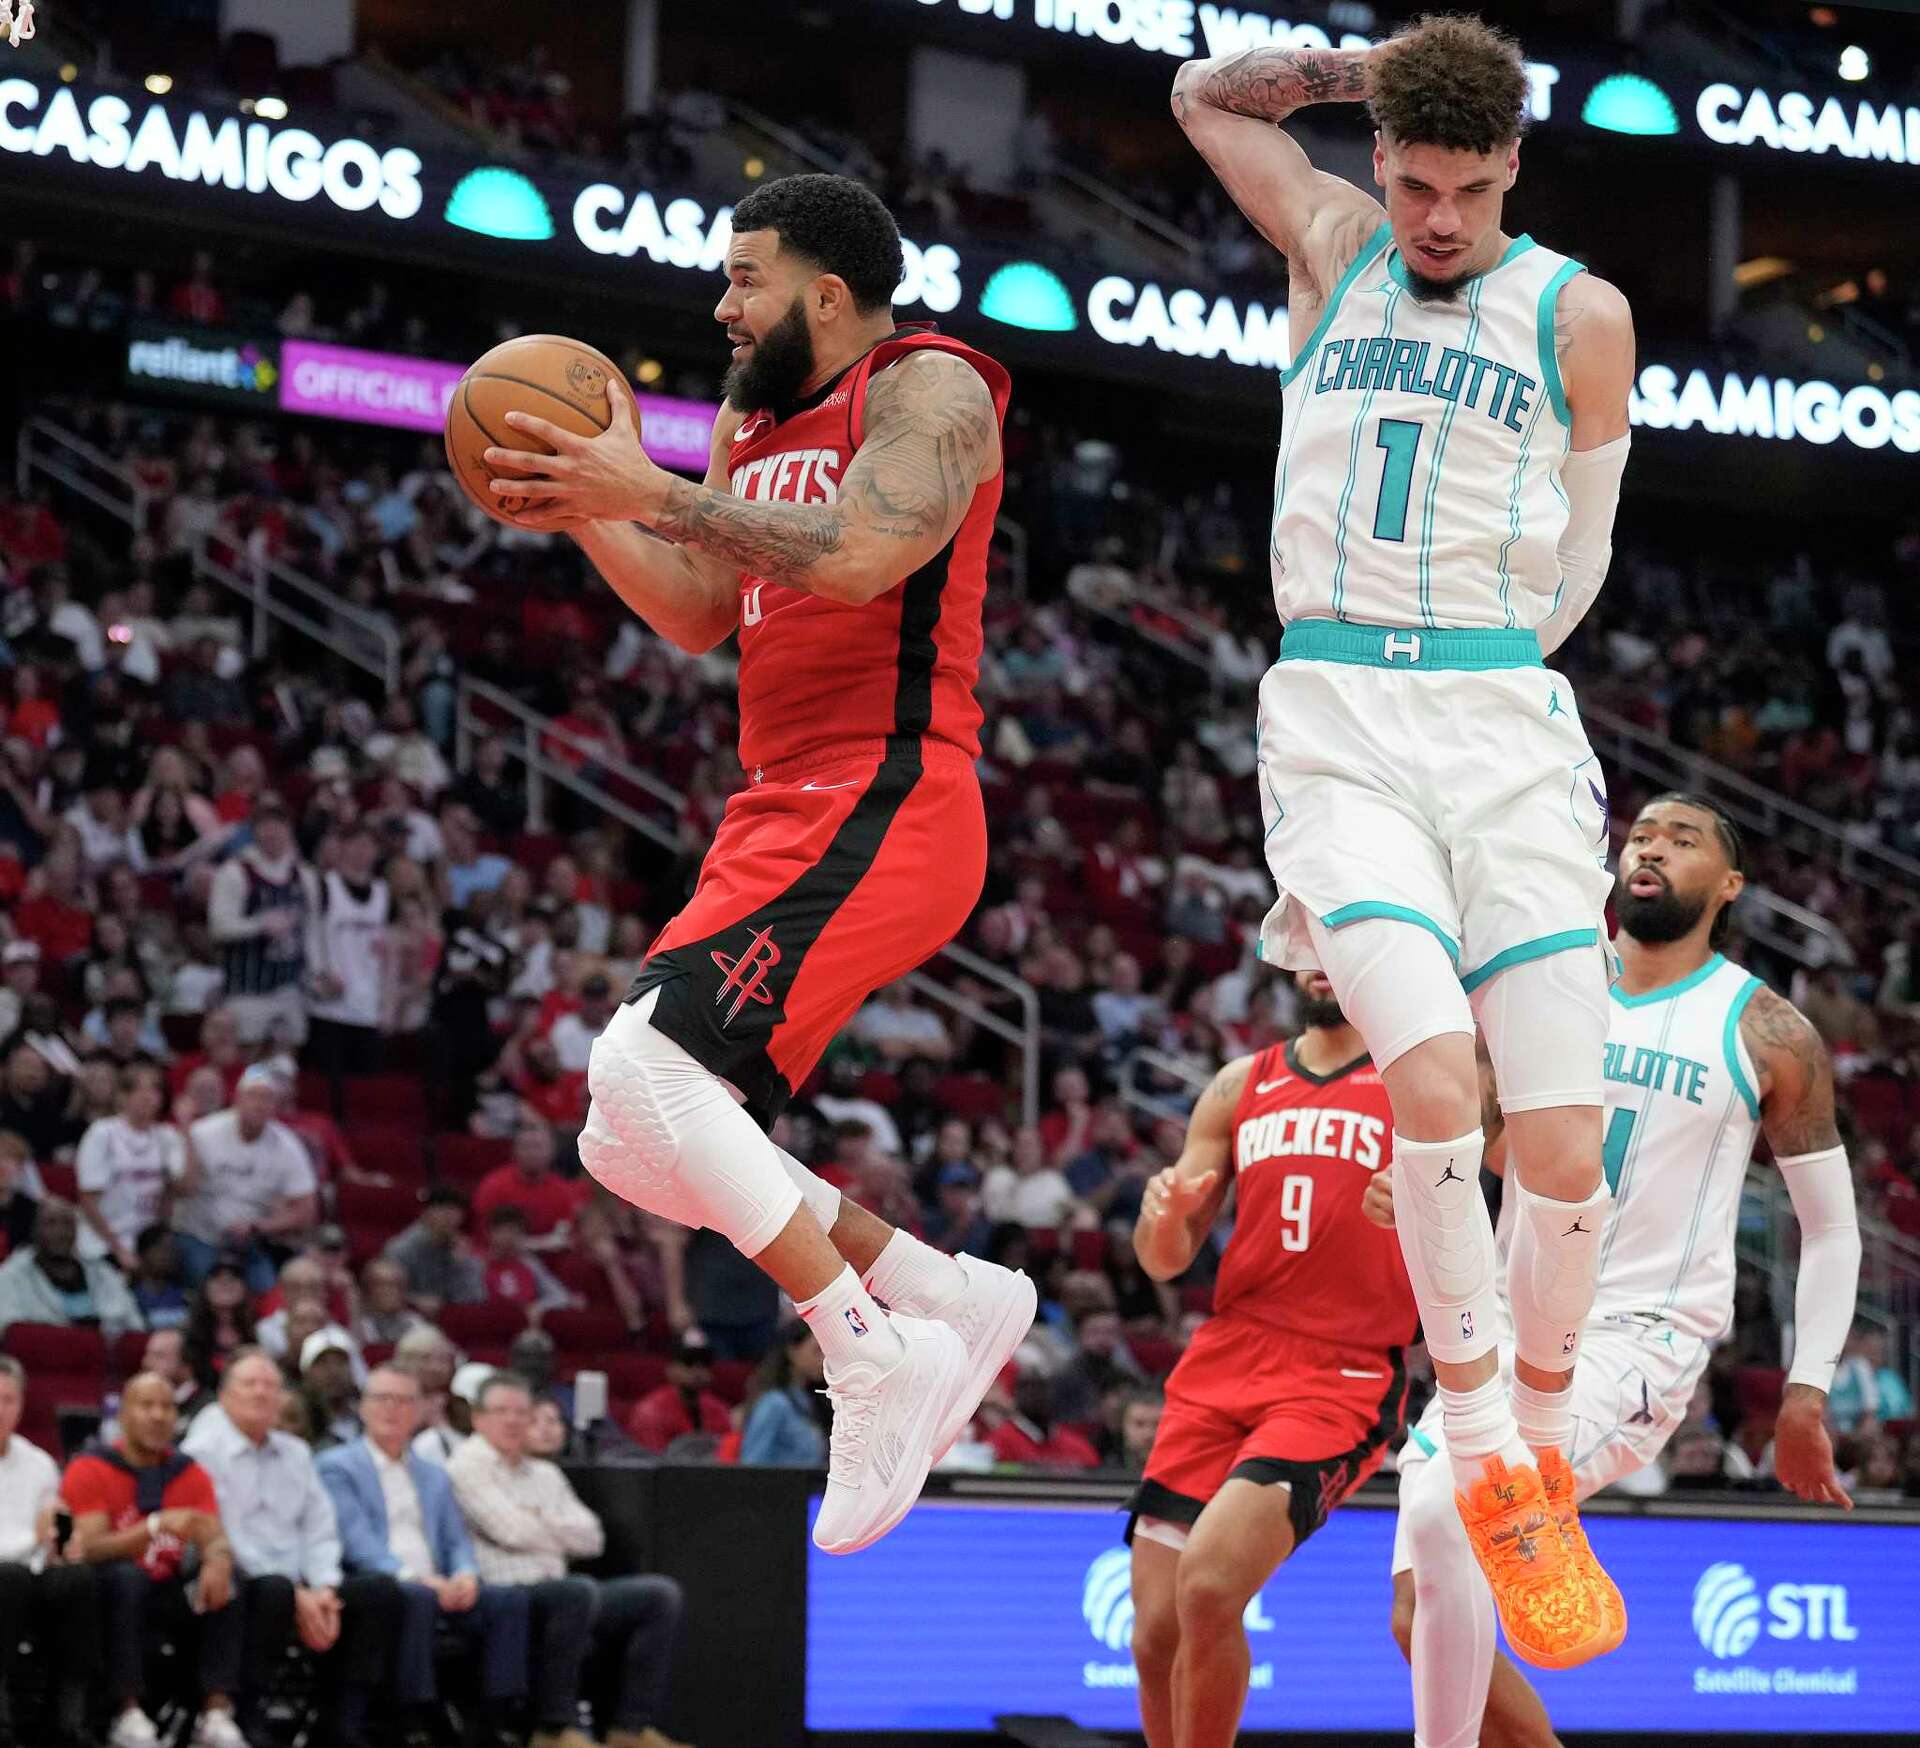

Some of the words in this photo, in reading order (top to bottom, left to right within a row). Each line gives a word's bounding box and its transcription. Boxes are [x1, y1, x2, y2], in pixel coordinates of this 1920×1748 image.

[1696, 82, 1920, 166] CASAMI
[0, 77, 424, 220] CASAMIGOS
[1087, 275, 1292, 370] CASAM
[1628, 364, 1920, 454] SAMIGOS
[130, 338, 240, 389] reliant
[293, 360, 437, 416] OFFICIAL
[1315, 337, 1536, 433] CHARLOTTE
[731, 448, 840, 505] OCKETS
[1373, 418, 1424, 542] 1
[1603, 1043, 1709, 1105] RLOTTE
[1237, 1107, 1385, 1173] ROCKETS
[1281, 1175, 1314, 1252] 9
[1767, 1582, 1858, 1640] STL
[1693, 1667, 1770, 1694] Satellite
[1772, 1667, 1858, 1694] Chemical
